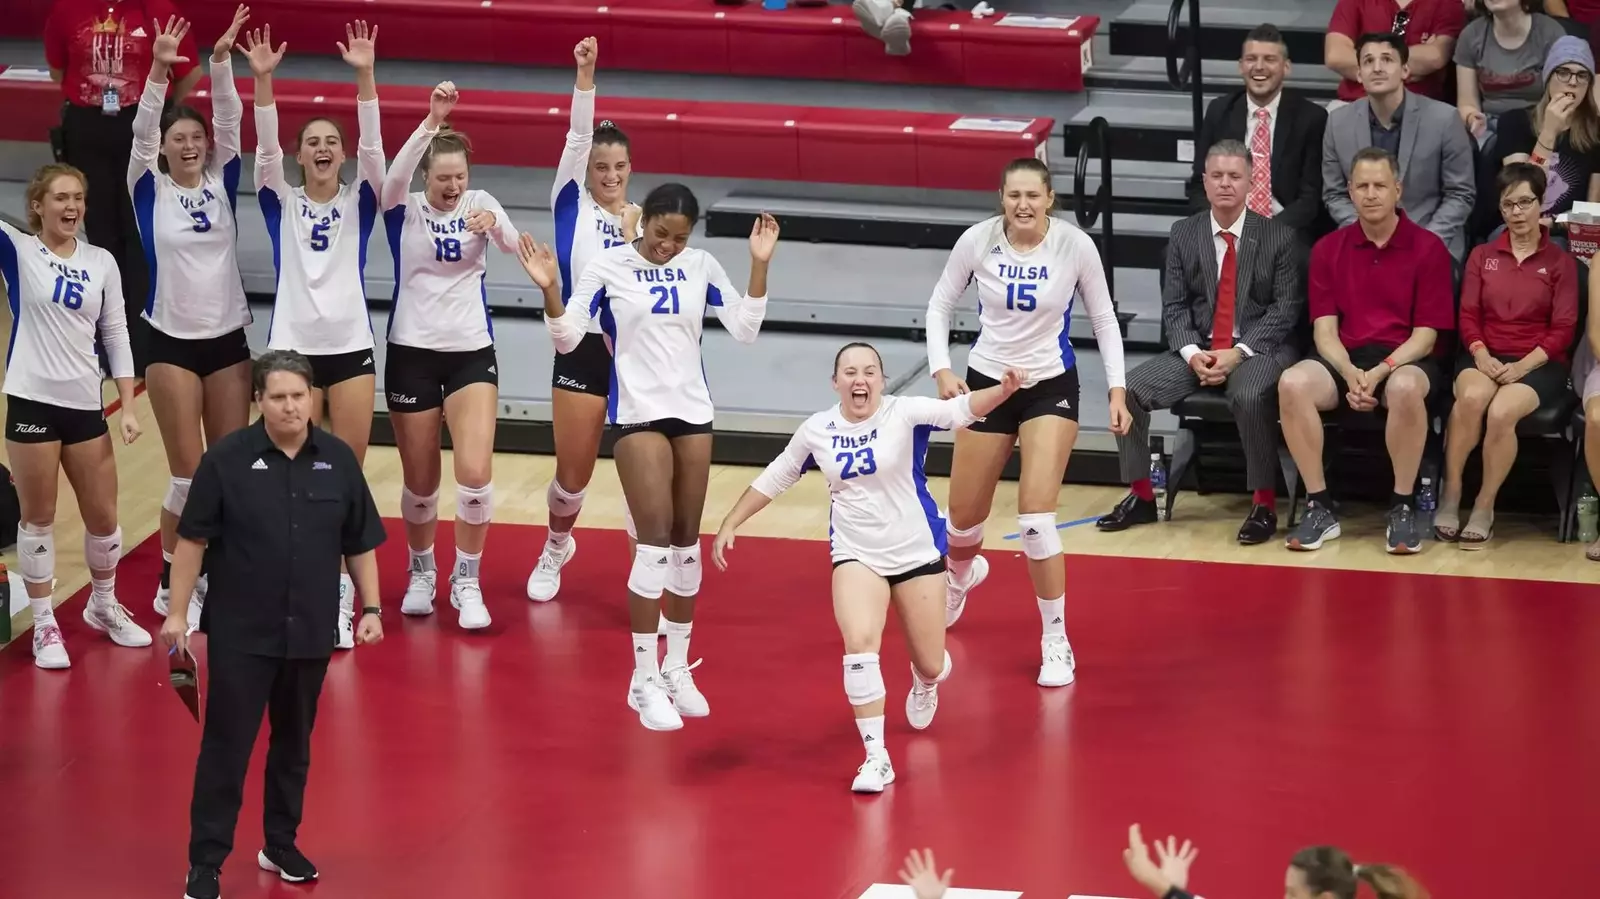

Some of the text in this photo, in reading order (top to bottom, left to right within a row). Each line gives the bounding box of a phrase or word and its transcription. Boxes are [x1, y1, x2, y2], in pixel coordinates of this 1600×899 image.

[177, 189, 215, 209] ULSA
[302, 204, 341, 226] TUSA
[310, 223, 330, 252] 5
[596, 219, 625, 238] TULS
[434, 236, 462, 263] 18
[998, 263, 1048, 280] TULSA
[1484, 257, 1500, 271] N
[633, 267, 687, 282] TULSA
[52, 274, 85, 311] 16
[649, 285, 680, 315] 21
[1006, 282, 1037, 312] 15
[557, 375, 587, 390] Tulsa
[390, 391, 417, 404] Tulsa
[15, 422, 48, 434] Tulsa
[832, 428, 878, 449] TULSA
[835, 447, 878, 481] 23
